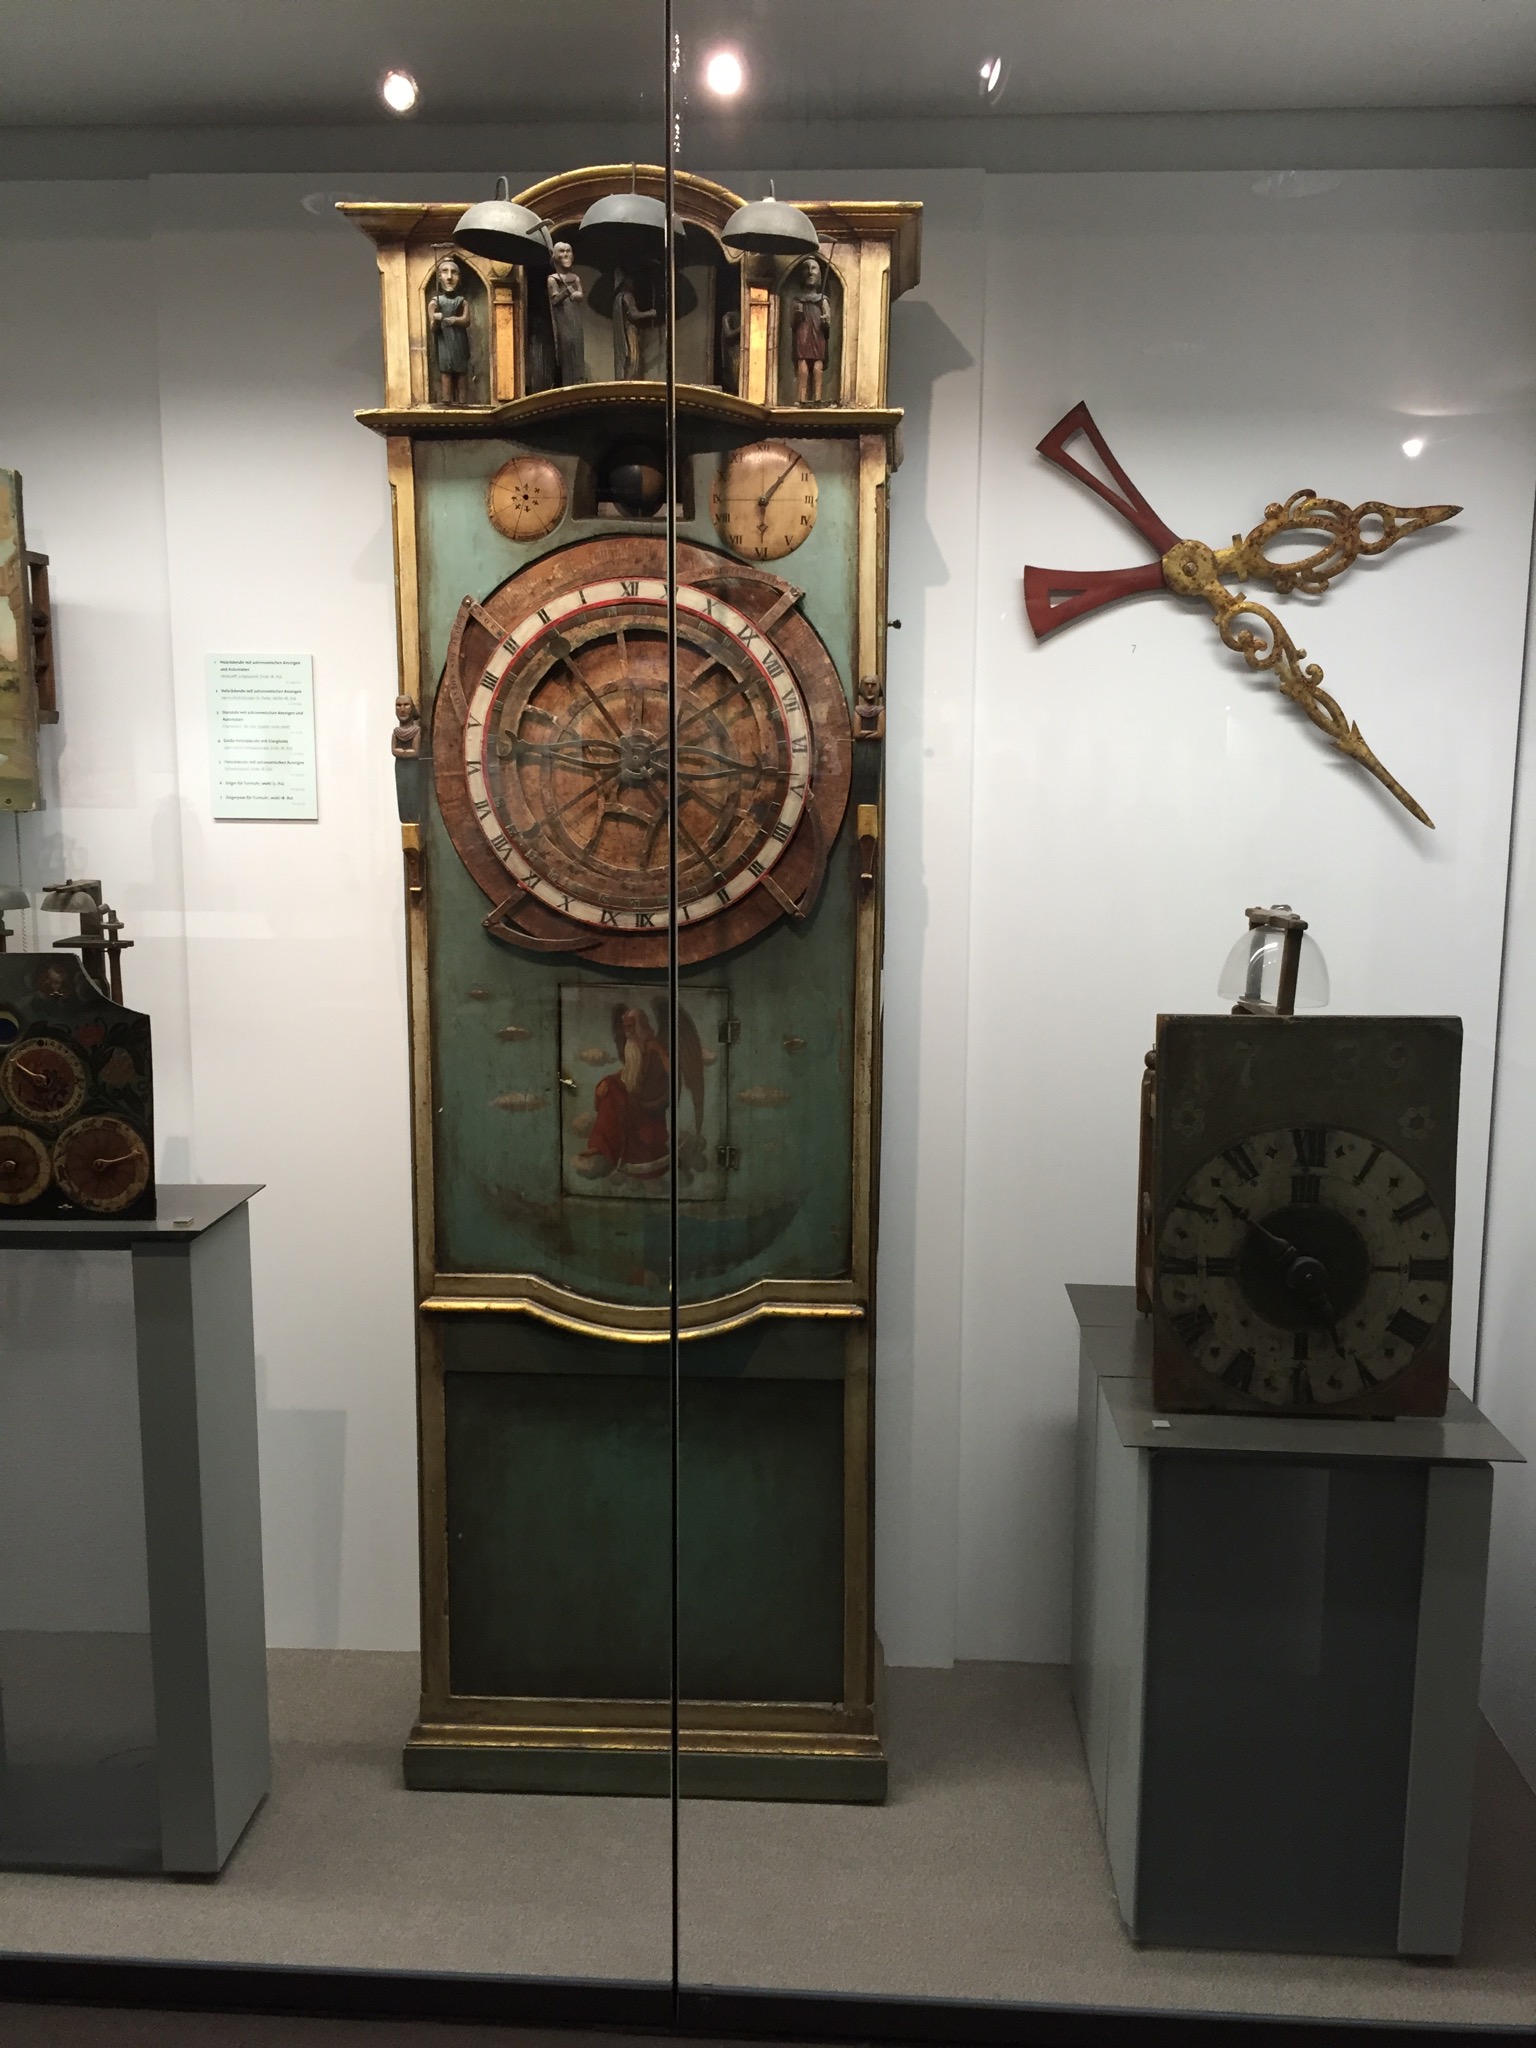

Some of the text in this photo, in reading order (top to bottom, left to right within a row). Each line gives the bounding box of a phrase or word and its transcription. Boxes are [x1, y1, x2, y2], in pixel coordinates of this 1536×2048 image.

[801, 473, 808, 482] II
[801, 515, 810, 525] IV
[730, 535, 743, 545] VII
[785, 535, 793, 546] V
[755, 547, 768, 558] VI
[621, 581, 640, 597] XII
[1131, 644, 1136, 653] 7
